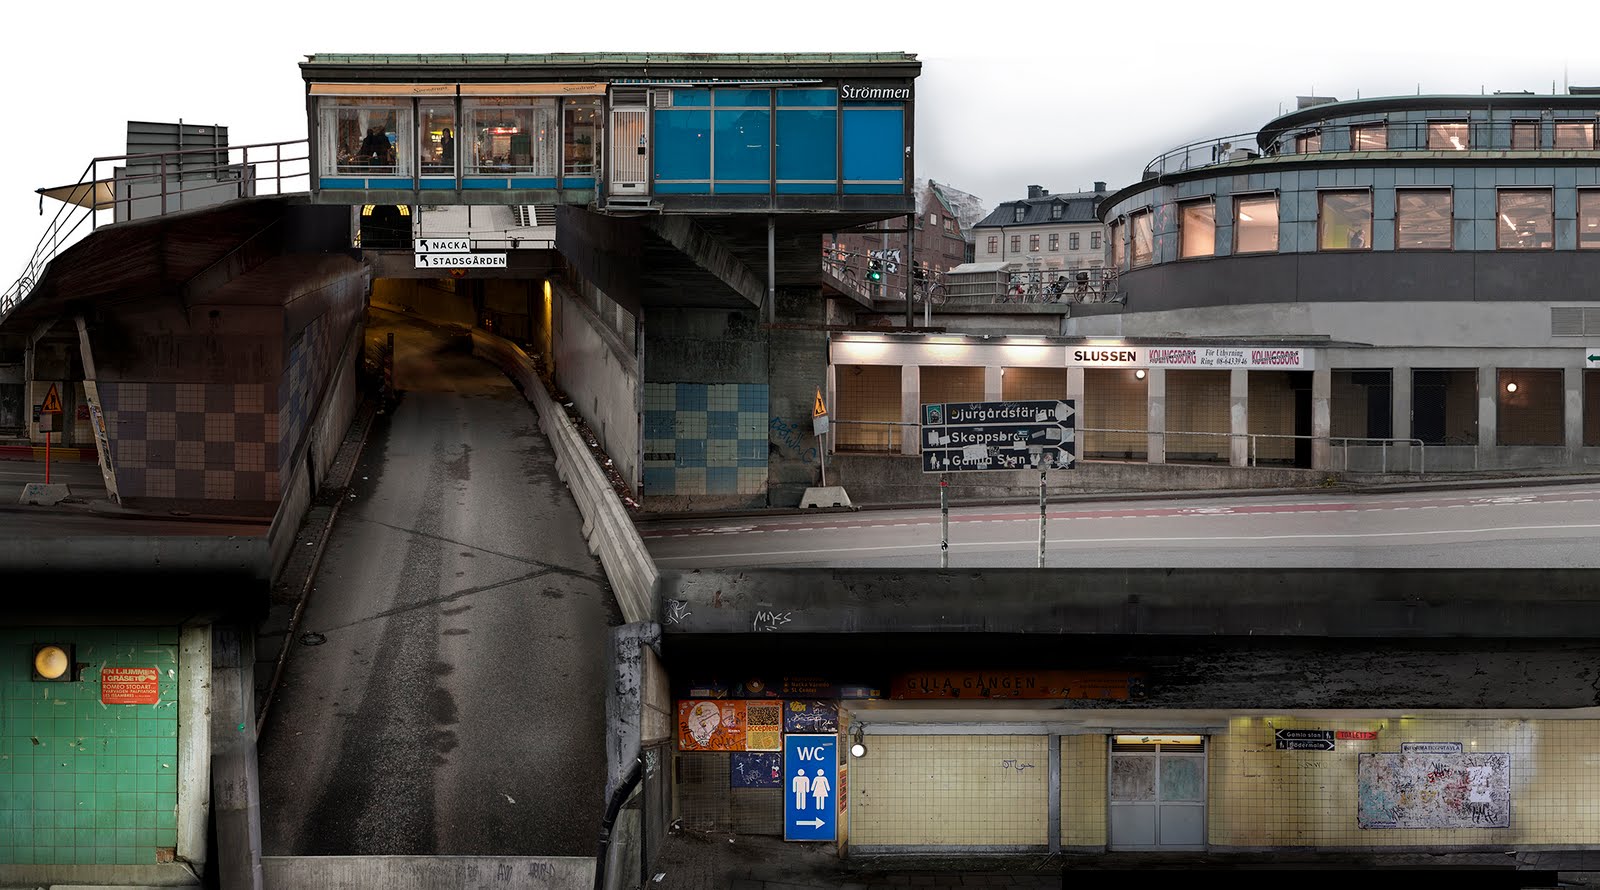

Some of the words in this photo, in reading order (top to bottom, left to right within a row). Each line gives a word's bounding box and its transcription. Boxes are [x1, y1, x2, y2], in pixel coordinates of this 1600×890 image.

[841, 84, 910, 99] Strömmen
[432, 241, 468, 249] NACKA
[433, 256, 505, 265] STADSGÅRDEN
[1074, 350, 1137, 362] SLUSSEN
[1148, 349, 1197, 364] KOLINGSBORG
[1205, 348, 1215, 356] För
[1251, 350, 1300, 365] KOLINGSBORG
[1200, 357, 1214, 366] Ring
[951, 431, 1028, 445] Skeppsbro
[907, 677, 953, 689] GULA
[963, 673, 1036, 689] GÅNGEN
[796, 746, 825, 761] WC
